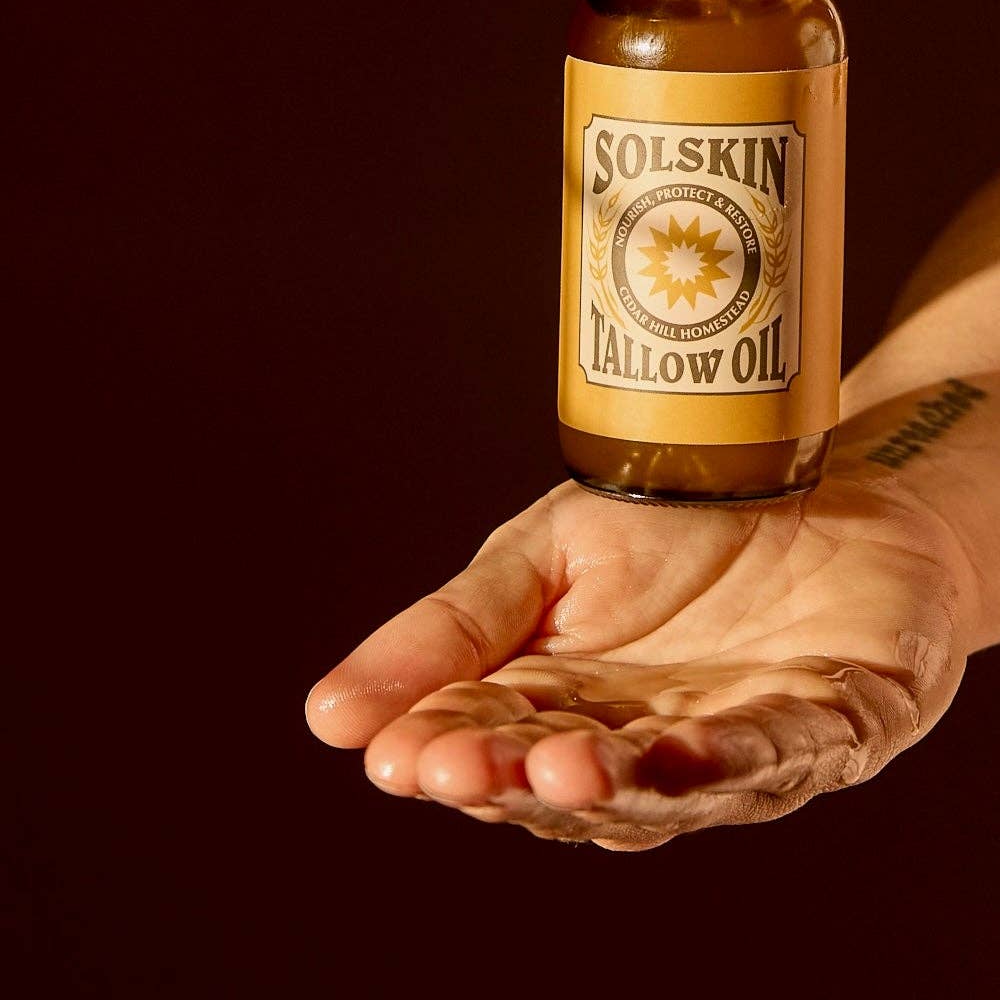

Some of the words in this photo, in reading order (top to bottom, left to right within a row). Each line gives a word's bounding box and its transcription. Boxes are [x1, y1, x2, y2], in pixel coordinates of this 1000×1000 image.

[592, 129, 789, 208] SOLSKIN
[614, 195, 656, 248] NOURISH,
[656, 186, 714, 204] PROTECT
[714, 197, 725, 209] &
[723, 203, 758, 255] RESTORE
[591, 299, 724, 384] TALLOW
[731, 314, 787, 384] OIL
[619, 286, 649, 325] CEDAR
[649, 320, 676, 339] HILL
[680, 290, 751, 340] HOMESTEAD
